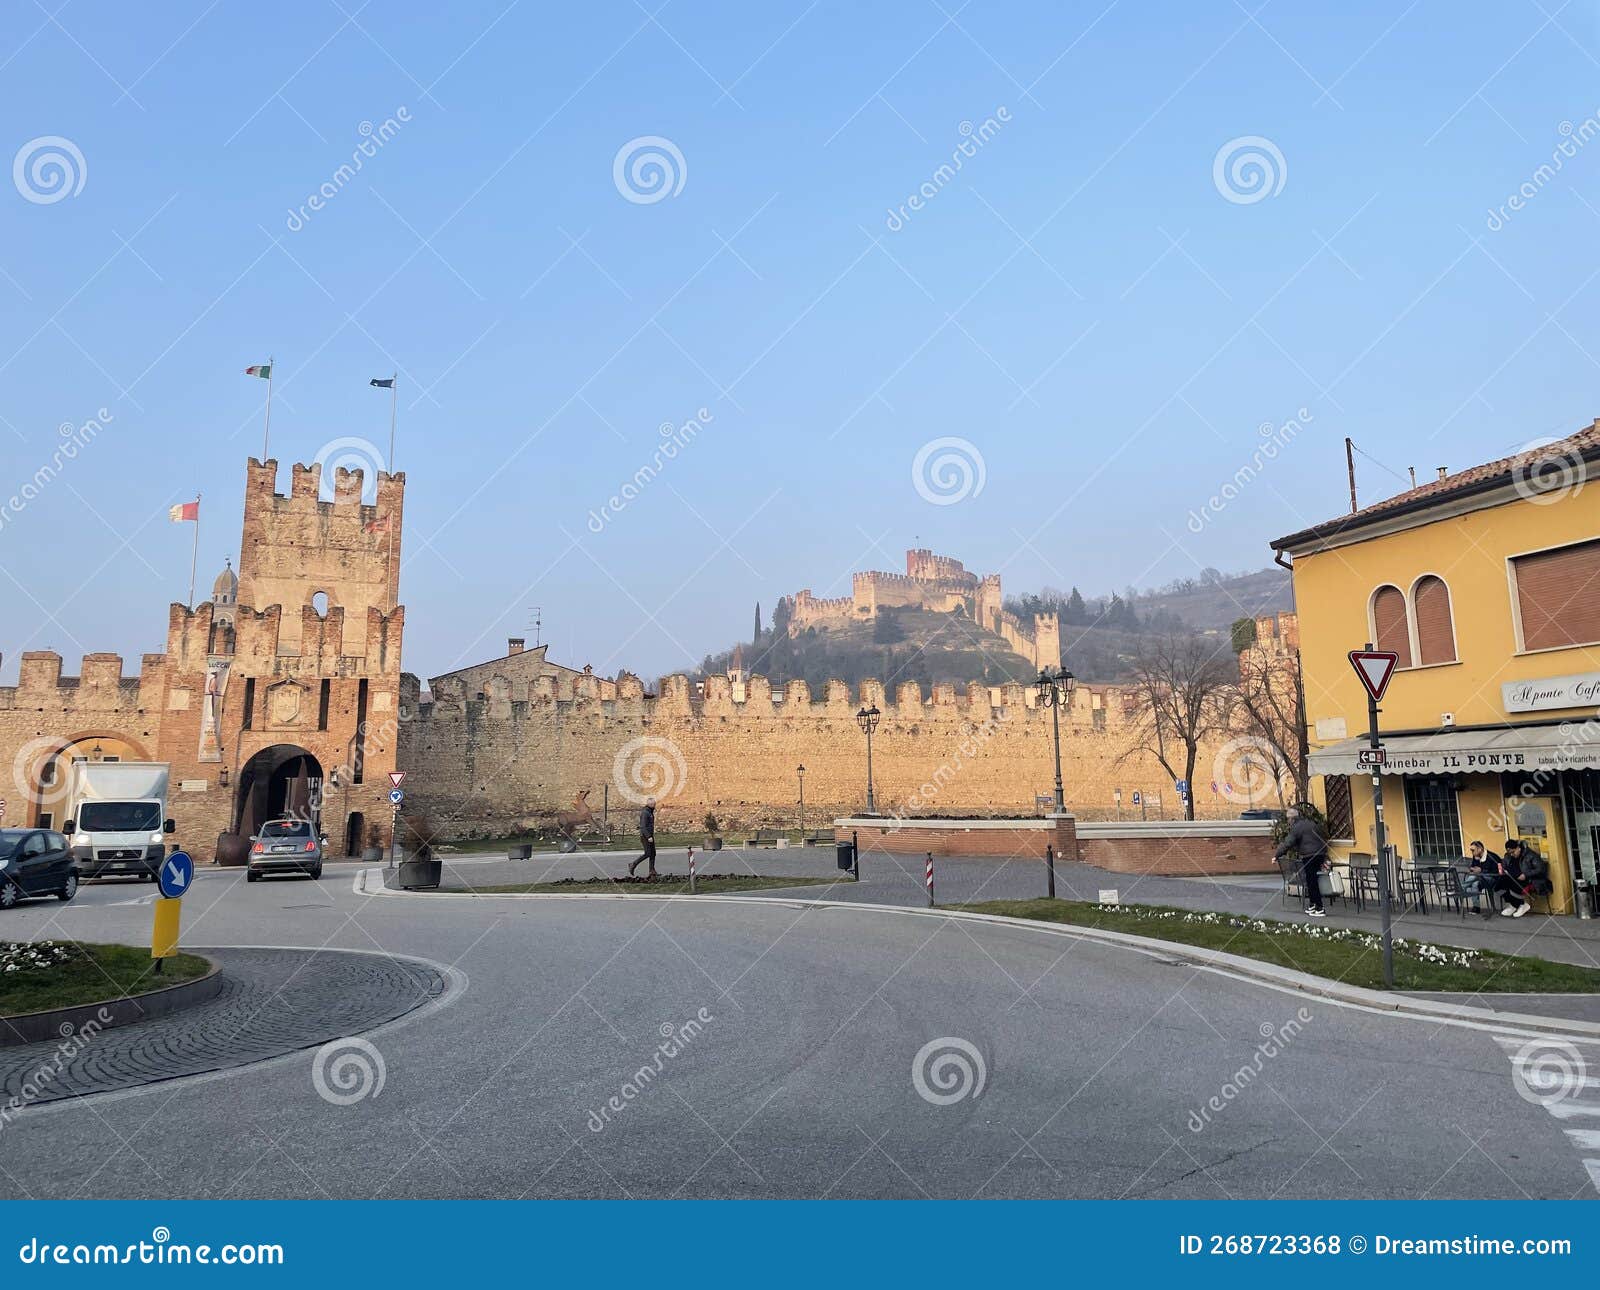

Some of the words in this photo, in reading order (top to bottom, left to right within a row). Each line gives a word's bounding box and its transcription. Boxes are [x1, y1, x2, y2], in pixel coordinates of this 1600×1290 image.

[1530, 689, 1563, 706] ponte
[1384, 757, 1431, 769] winebar
[1443, 756, 1460, 767] IL
[1467, 754, 1525, 766] PONTE
